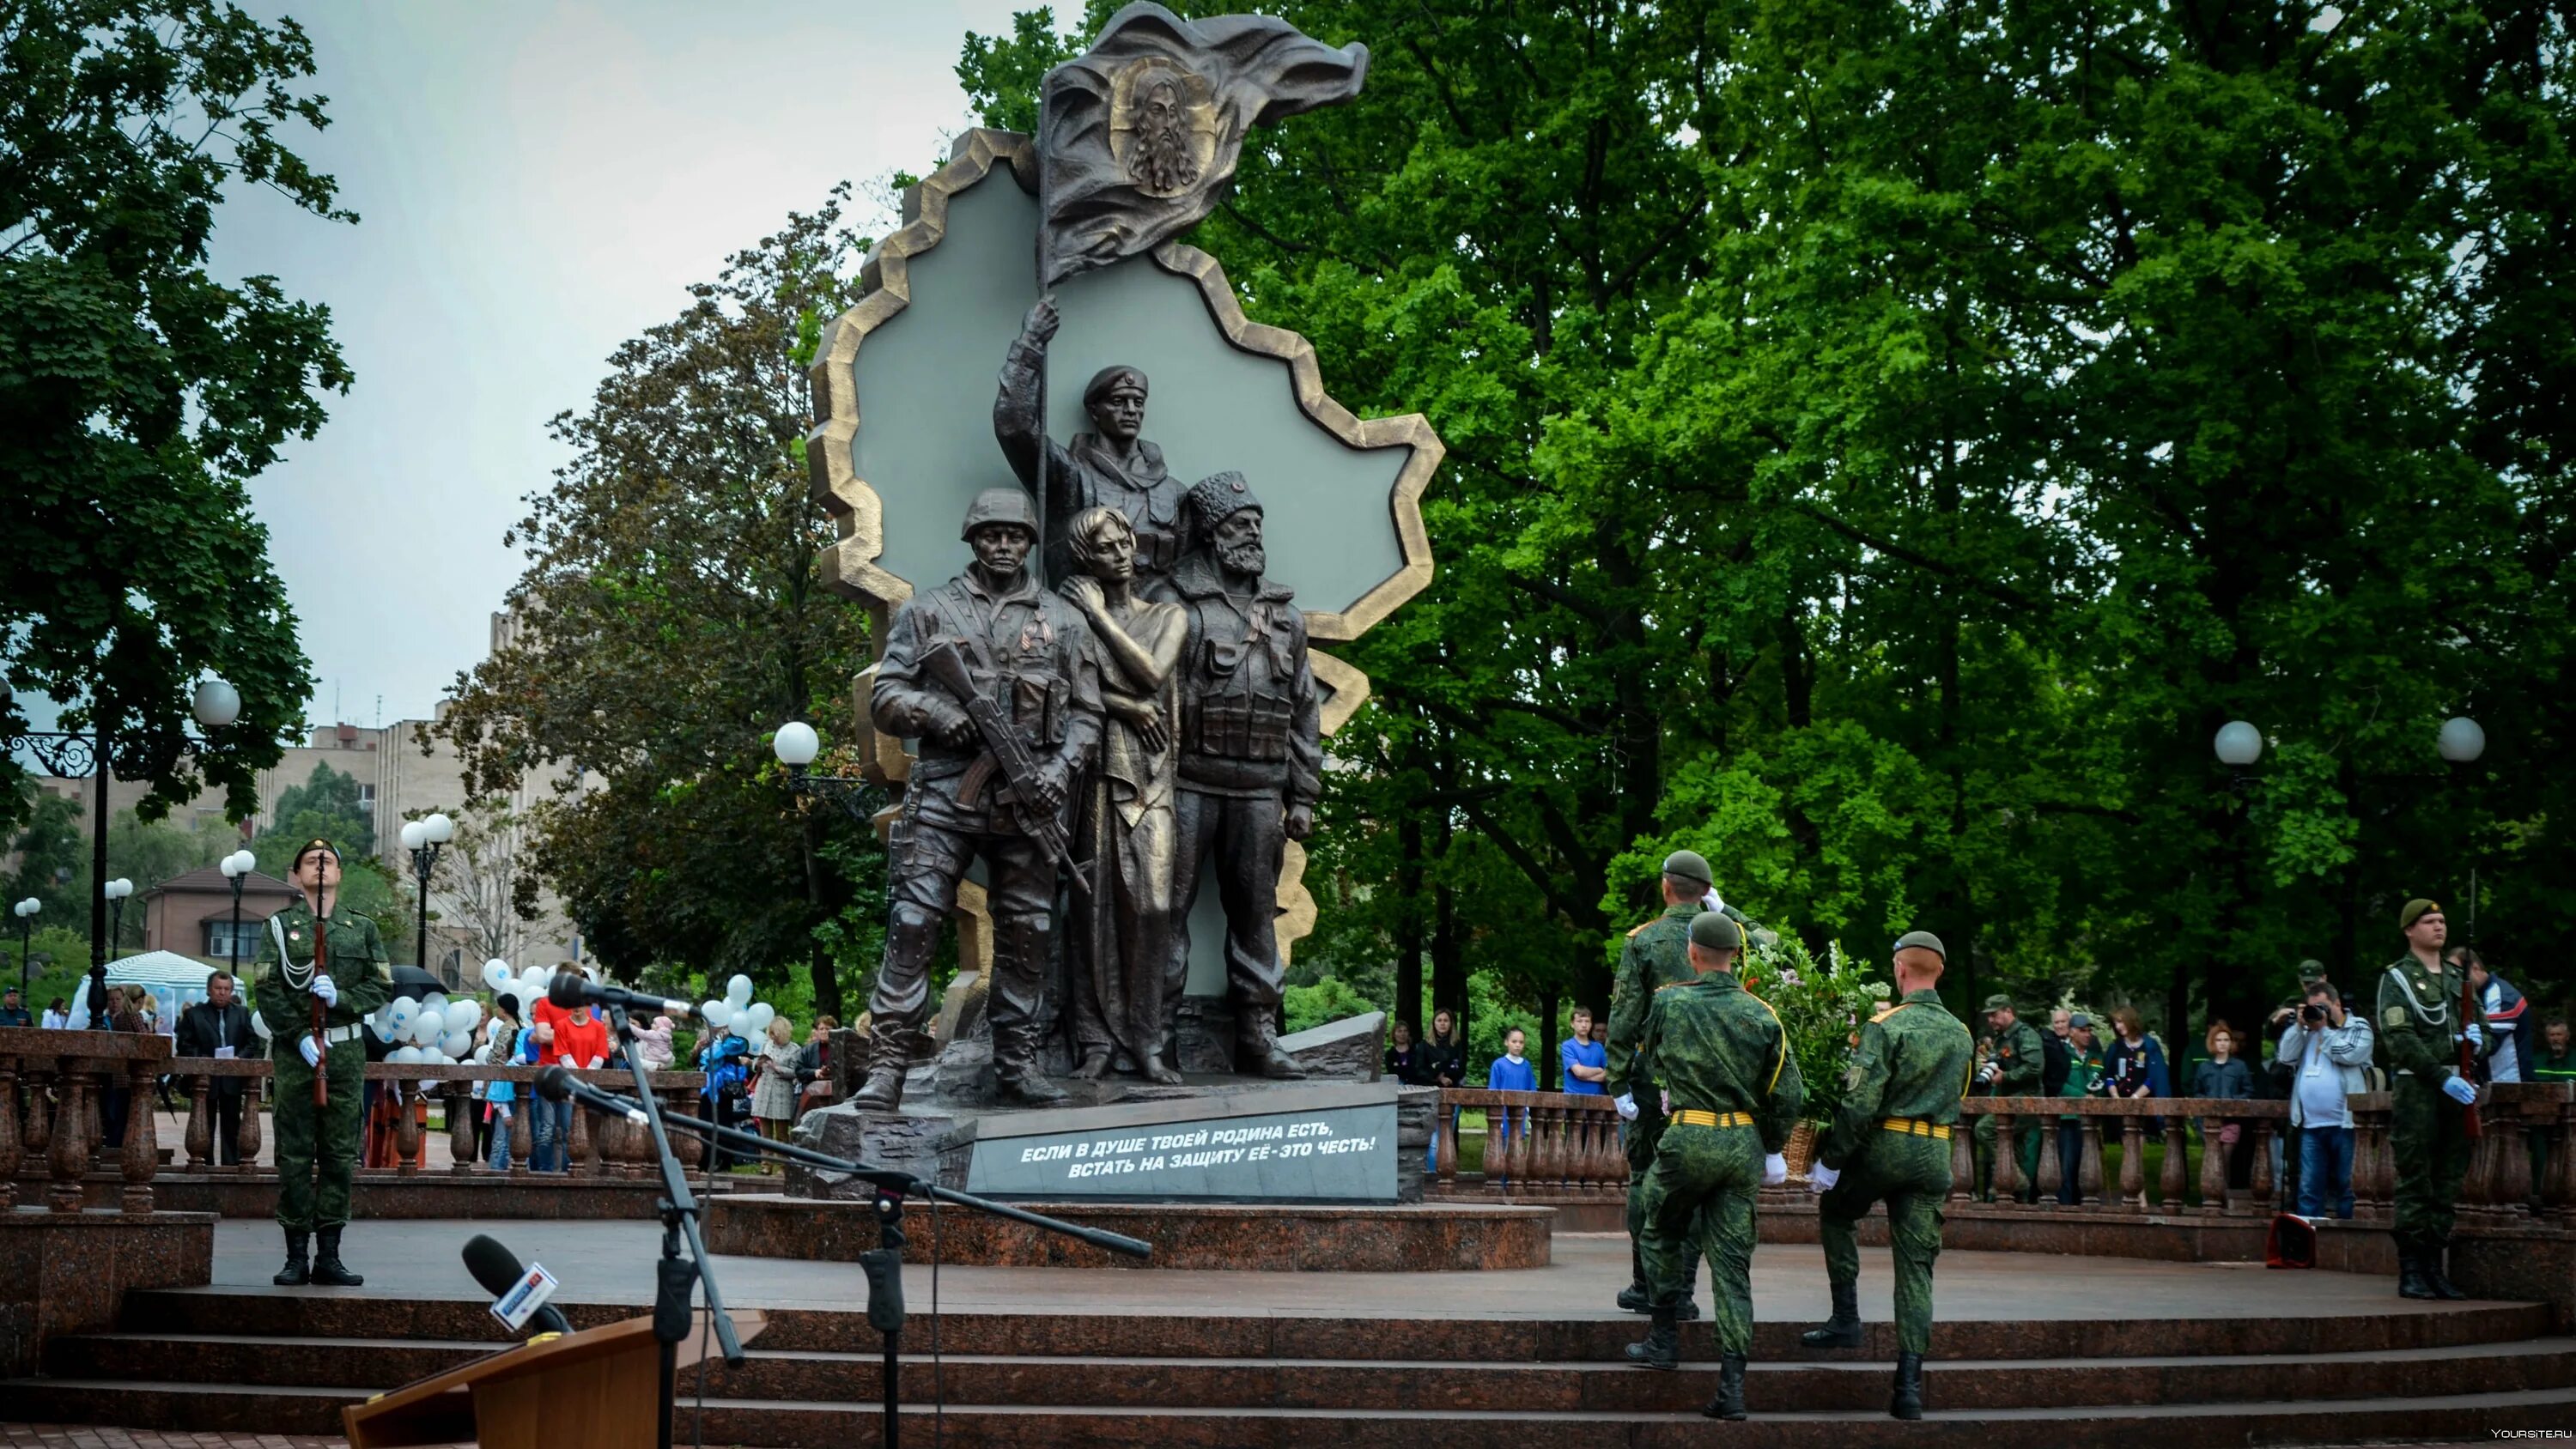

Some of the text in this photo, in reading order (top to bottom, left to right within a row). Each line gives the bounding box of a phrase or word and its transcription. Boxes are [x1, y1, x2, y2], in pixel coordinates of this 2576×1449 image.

[1020, 1121, 1334, 1163] ЕСЛИ В ДУШЕ ТВОЕЙ РОДИНА ЕСТЬ,
[1067, 1159, 1135, 1179] ВСТАТЬ
[1139, 1155, 1164, 1172] НА
[1169, 1146, 1246, 1168] ЗАЩИТУ
[1317, 1136, 1376, 1155] ЧЕСТЬ!
